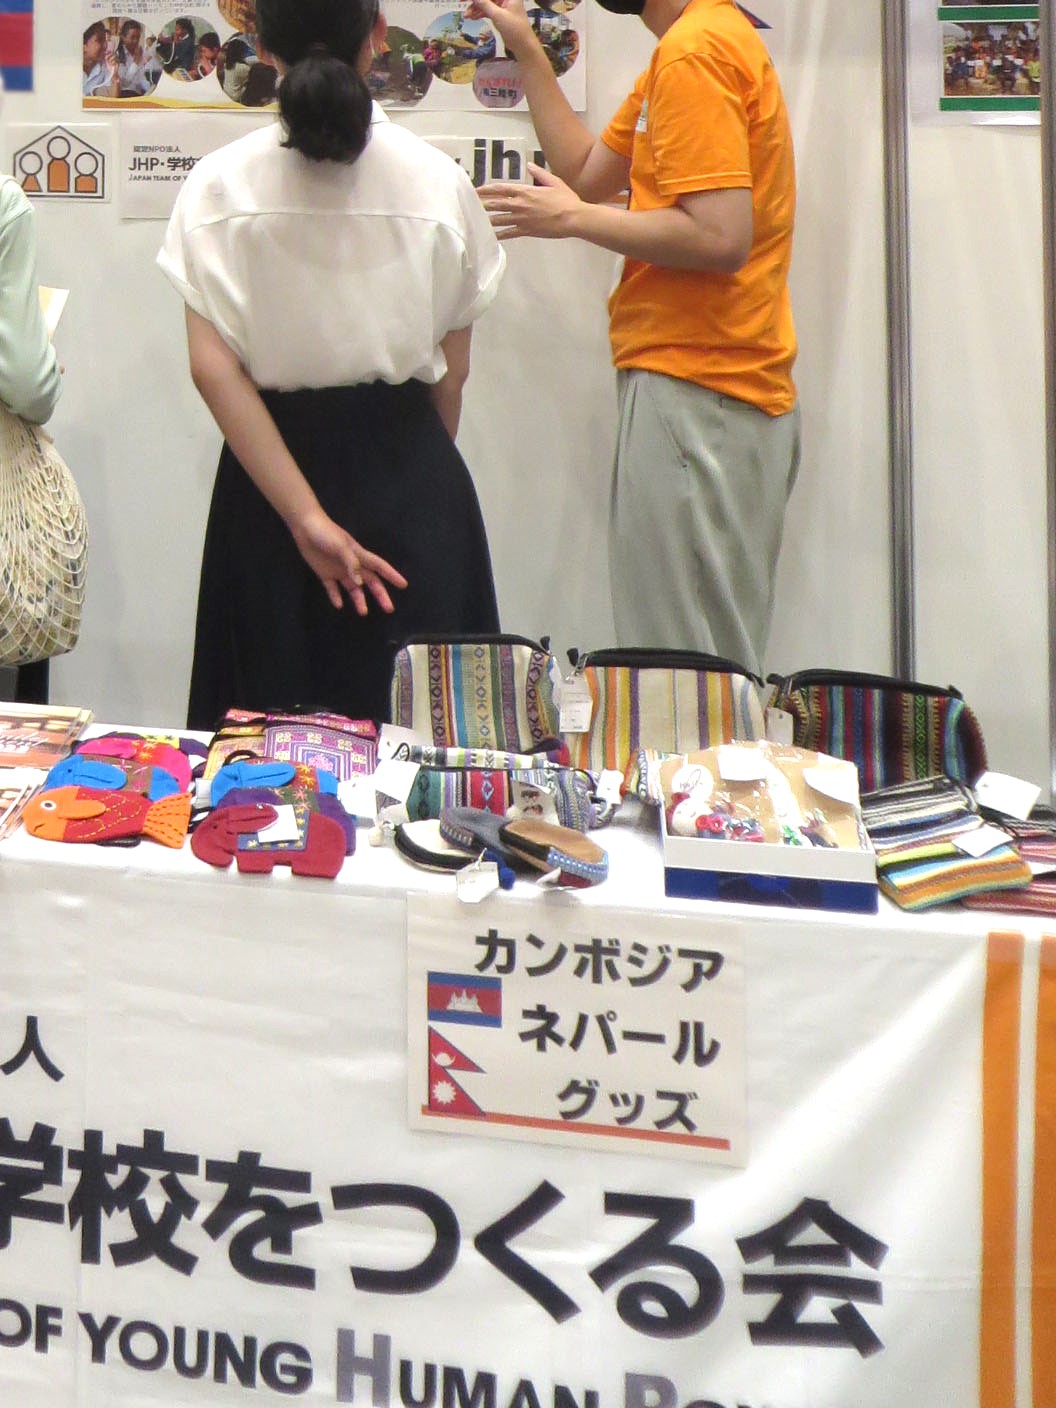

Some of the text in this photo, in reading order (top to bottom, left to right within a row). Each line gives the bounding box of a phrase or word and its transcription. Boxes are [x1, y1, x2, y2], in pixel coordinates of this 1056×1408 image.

[128, 156, 203, 172] JHP・学校
[475, 928, 724, 992] カンボジア
[518, 1004, 721, 1068] ネパール
[557, 1078, 699, 1133] グッズ
[77, 1312, 313, 1395] YOUNG
